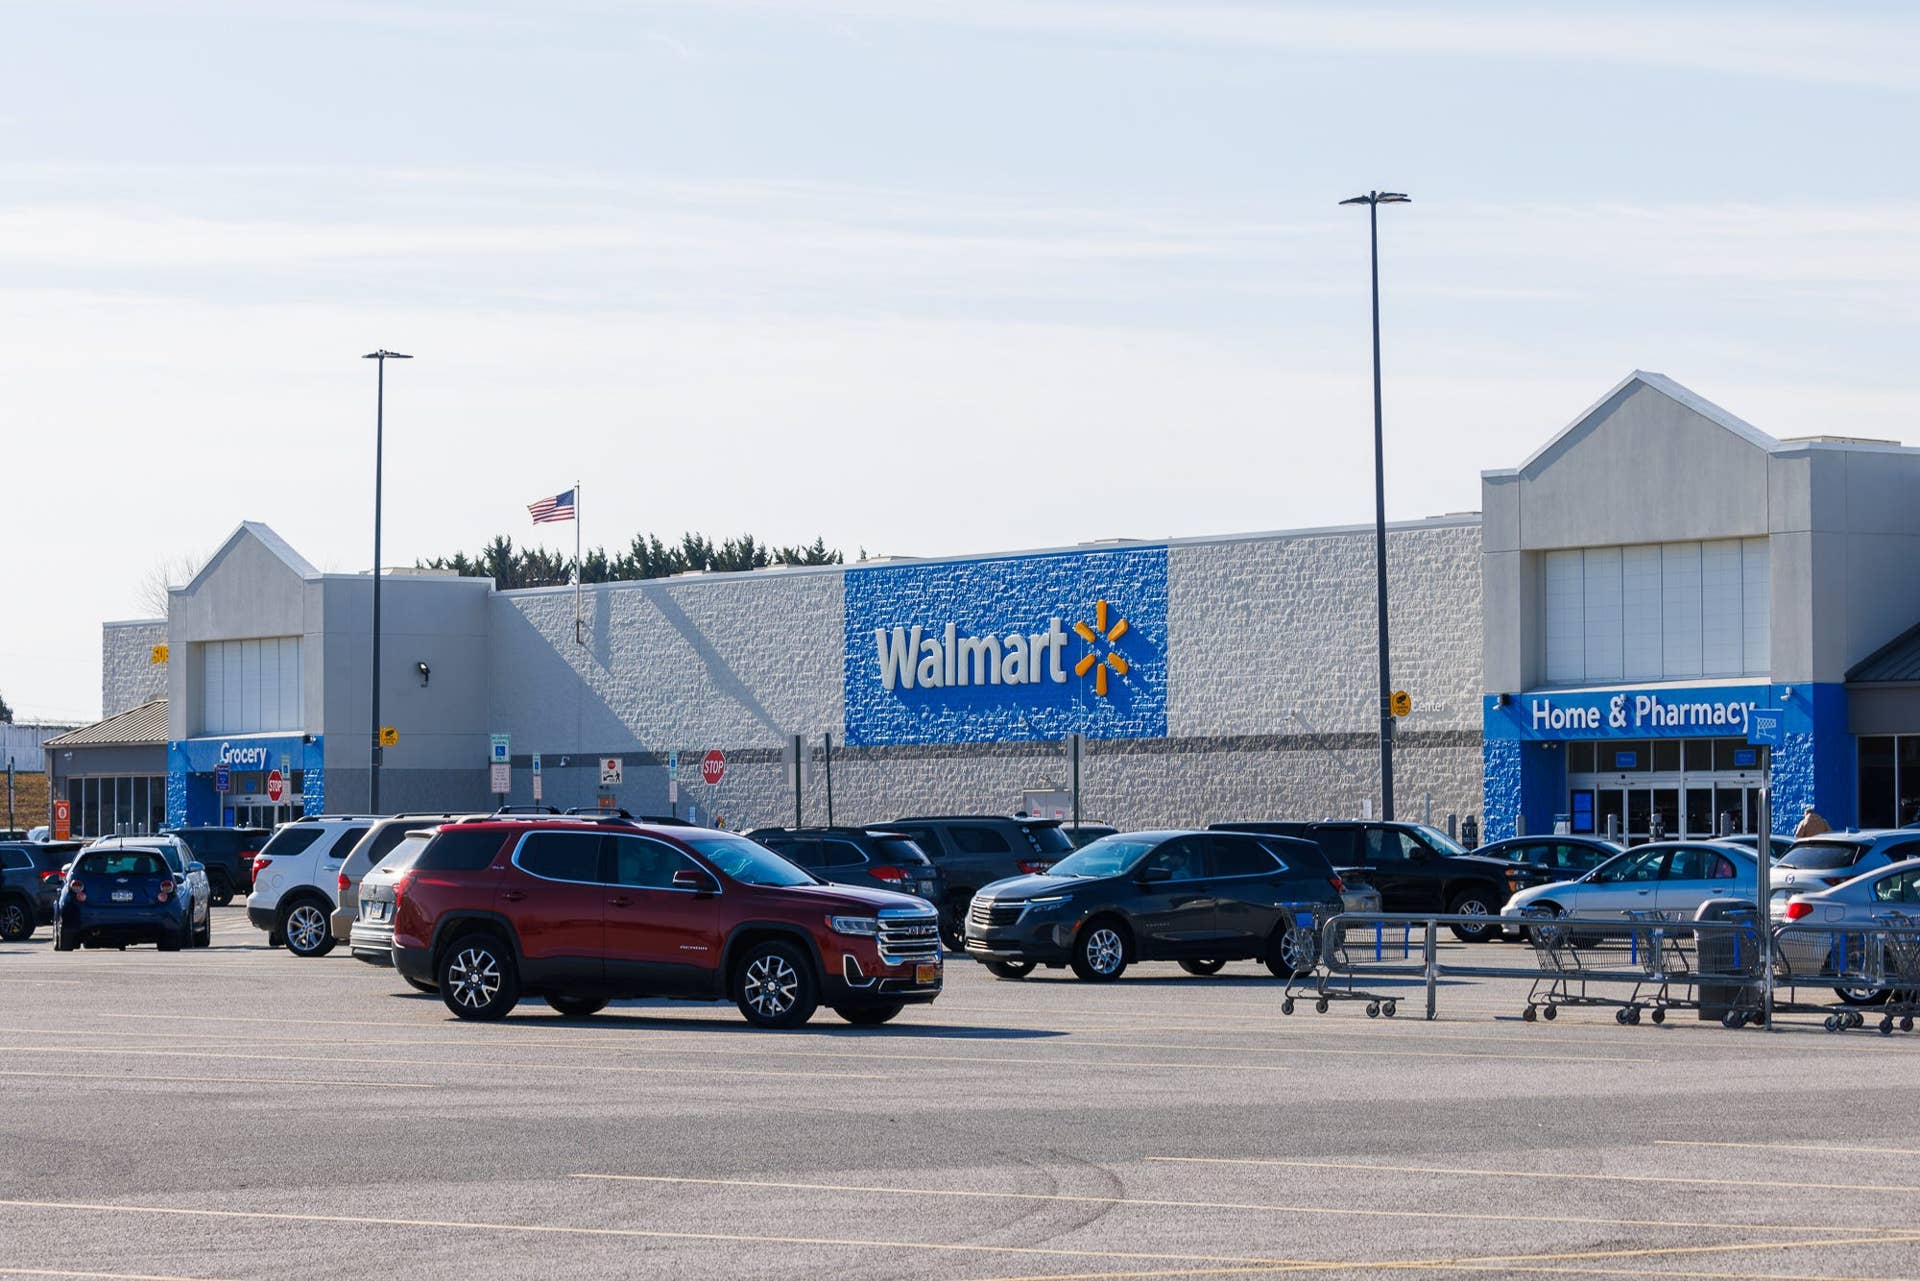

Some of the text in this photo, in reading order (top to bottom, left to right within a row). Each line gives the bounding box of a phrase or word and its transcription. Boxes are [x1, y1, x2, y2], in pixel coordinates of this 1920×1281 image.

[875, 617, 1068, 690] Walmart
[1532, 695, 1756, 734] Home & Pharmacy
[220, 742, 267, 770] Grocery
[703, 760, 724, 774] STOP
[269, 780, 282, 793] STOP
